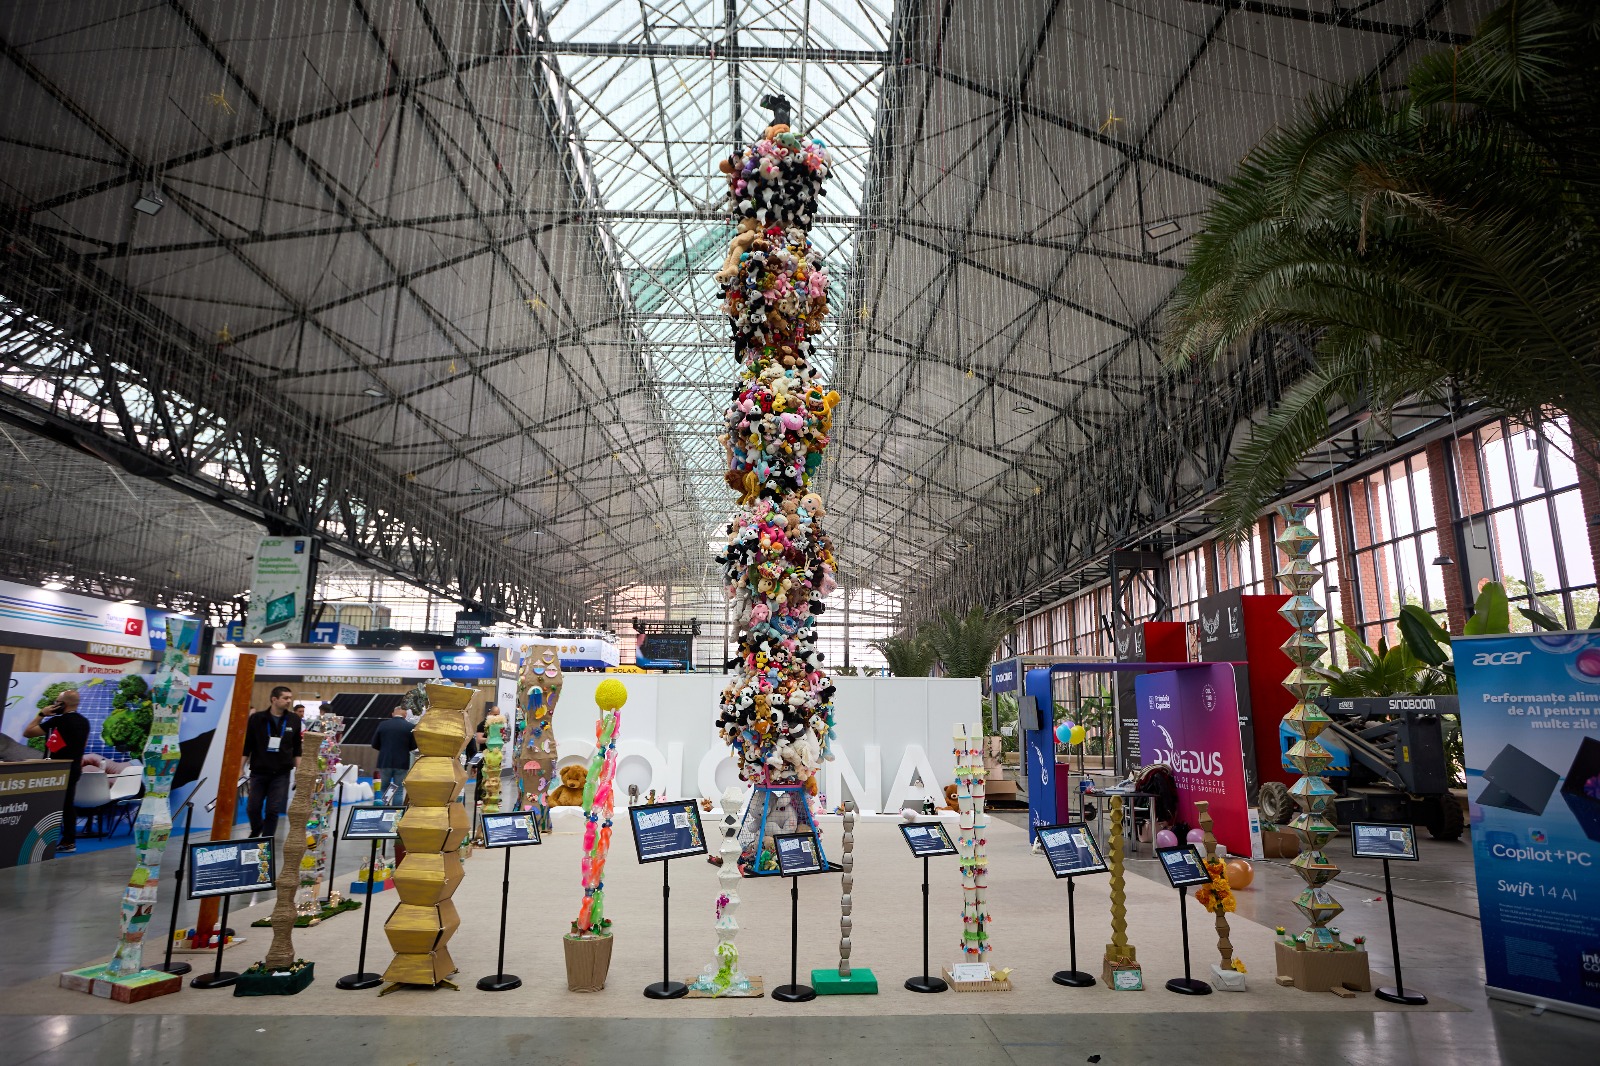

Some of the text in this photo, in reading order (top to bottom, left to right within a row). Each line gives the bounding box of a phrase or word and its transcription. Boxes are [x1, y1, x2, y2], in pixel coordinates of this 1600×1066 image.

[455, 637, 470, 647] 480
[89, 642, 152, 660] WORLDCHEM
[215, 654, 265, 667] Türe
[1472, 651, 1531, 666] acer
[303, 675, 401, 685] KAAN SOLAR MAESTRO
[1388, 698, 1436, 710] SINOBOOM
[1482, 692, 1600, 705] Performanțe alim
[1507, 706, 1524, 716] de
[1543, 705, 1590, 718] pentru
[1531, 719, 1598, 729] multe zile
[0, 774, 66, 791] LİSS ENERJİ
[1192, 778, 1225, 788] PROIECTE
[1198, 785, 1226, 795] SPORTIVE
[0, 802, 28, 814] urkish
[0, 815, 21, 826] nergy
[1492, 844, 1592, 867] Copilot+PC
[1497, 880, 1577, 901] Swift 14 AI
[1581, 951, 1600, 964] int
